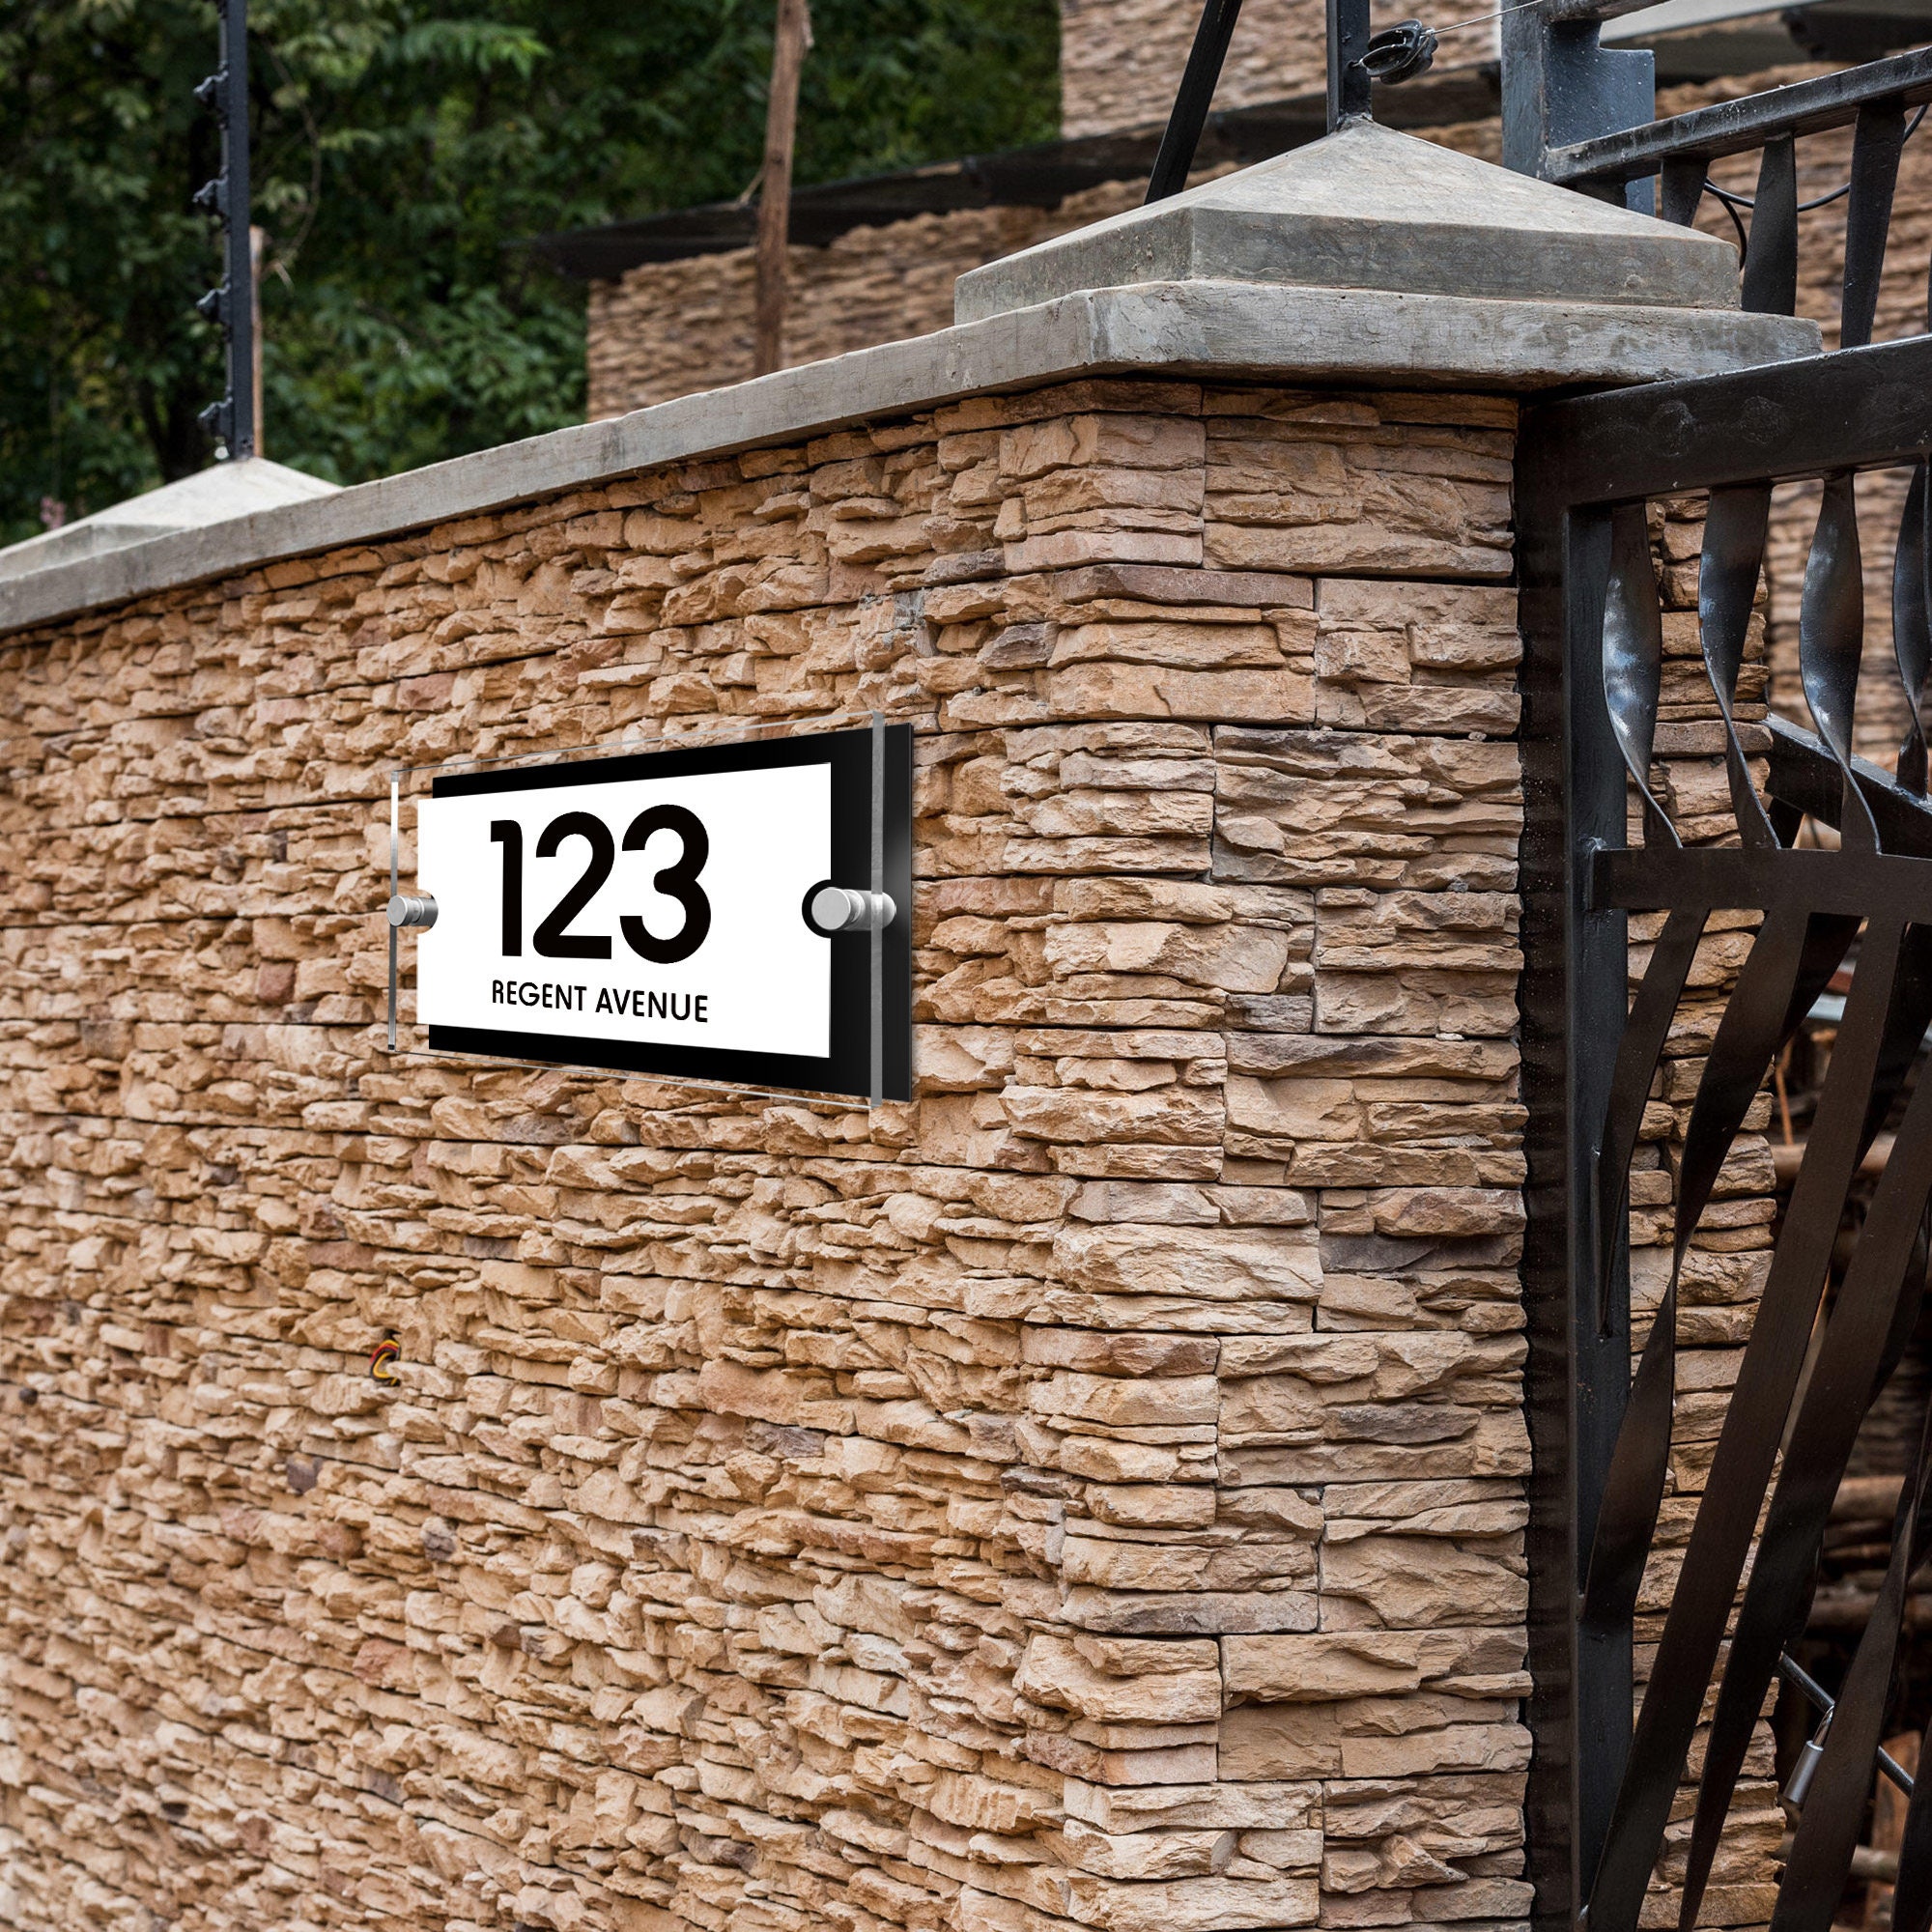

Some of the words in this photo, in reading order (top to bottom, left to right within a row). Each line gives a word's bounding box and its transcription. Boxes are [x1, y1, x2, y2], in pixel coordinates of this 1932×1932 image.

[491, 804, 712, 964] 123
[493, 979, 586, 1011] REGENT
[595, 987, 708, 1023] AVENUE
